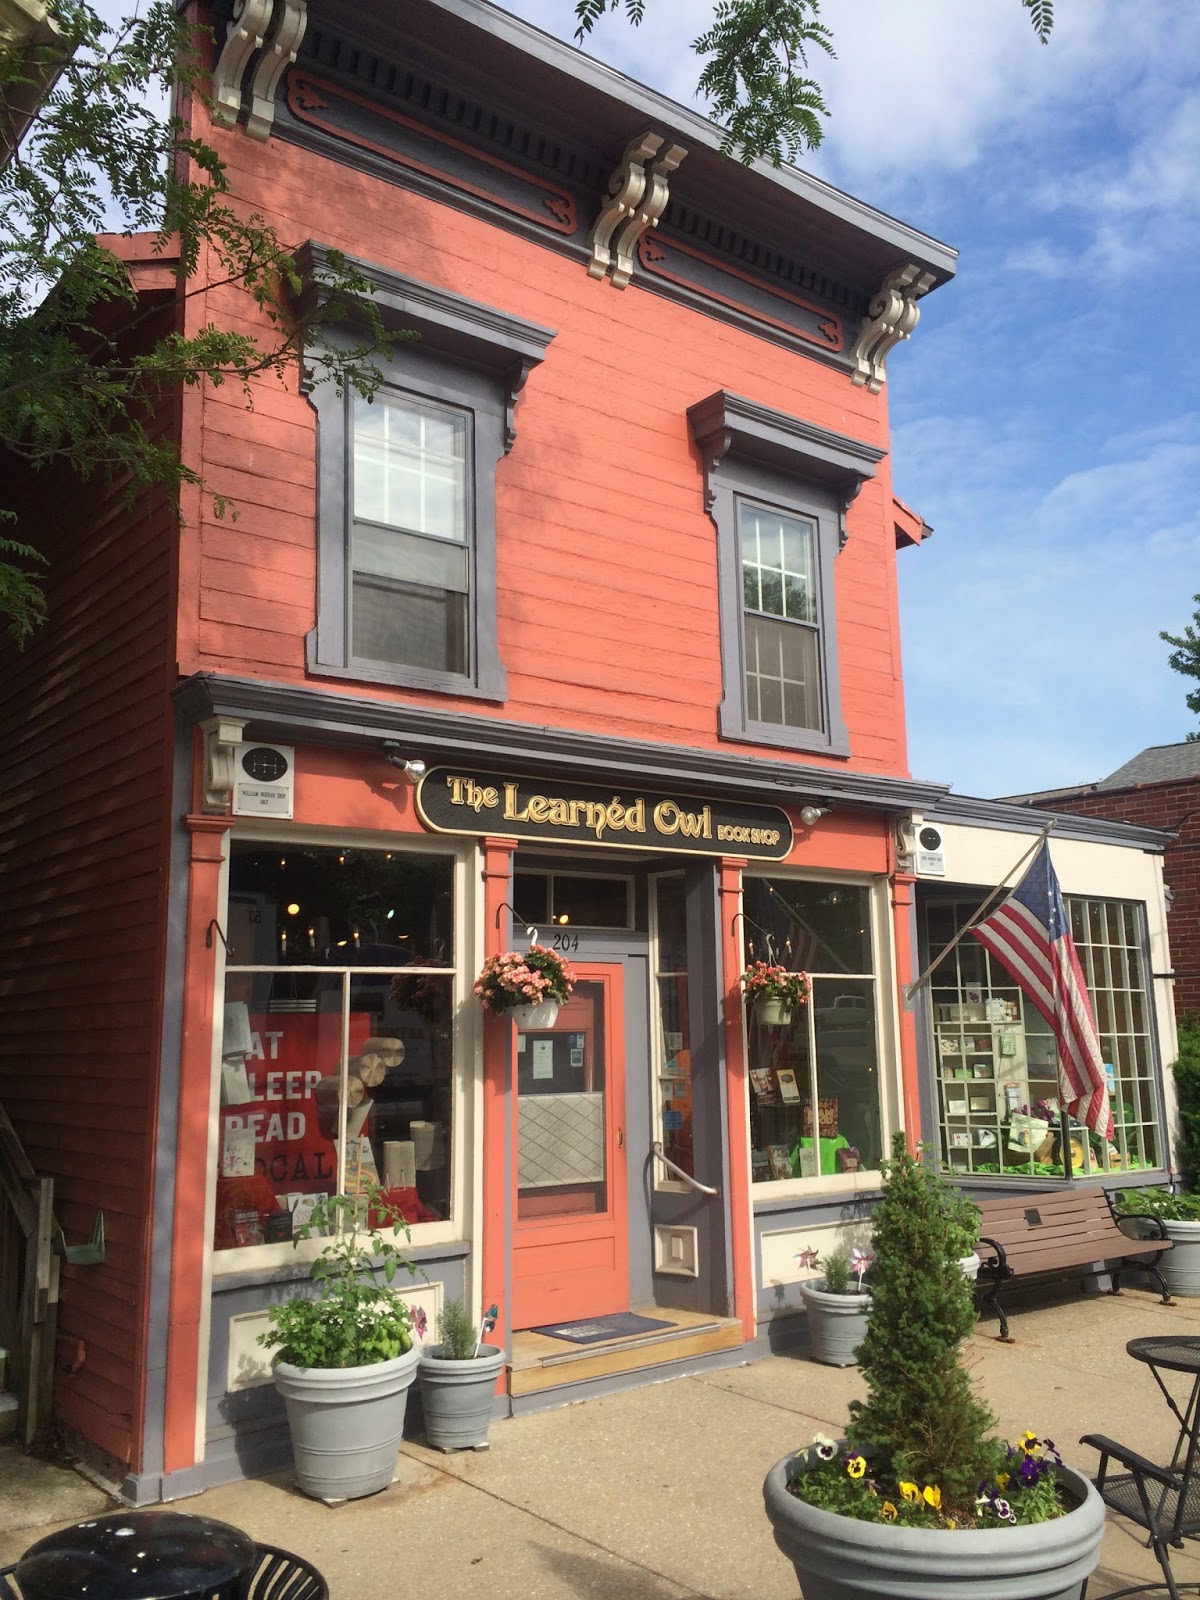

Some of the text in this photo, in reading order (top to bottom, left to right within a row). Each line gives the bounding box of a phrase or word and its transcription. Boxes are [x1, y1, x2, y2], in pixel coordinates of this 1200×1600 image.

[446, 775, 499, 812] The
[503, 781, 646, 839] Learnéd
[653, 799, 712, 840] Owl
[552, 933, 579, 953] 204
[246, 1032, 284, 1060] AT
[250, 1071, 322, 1101] LEEP
[255, 1152, 332, 1183] CAL
